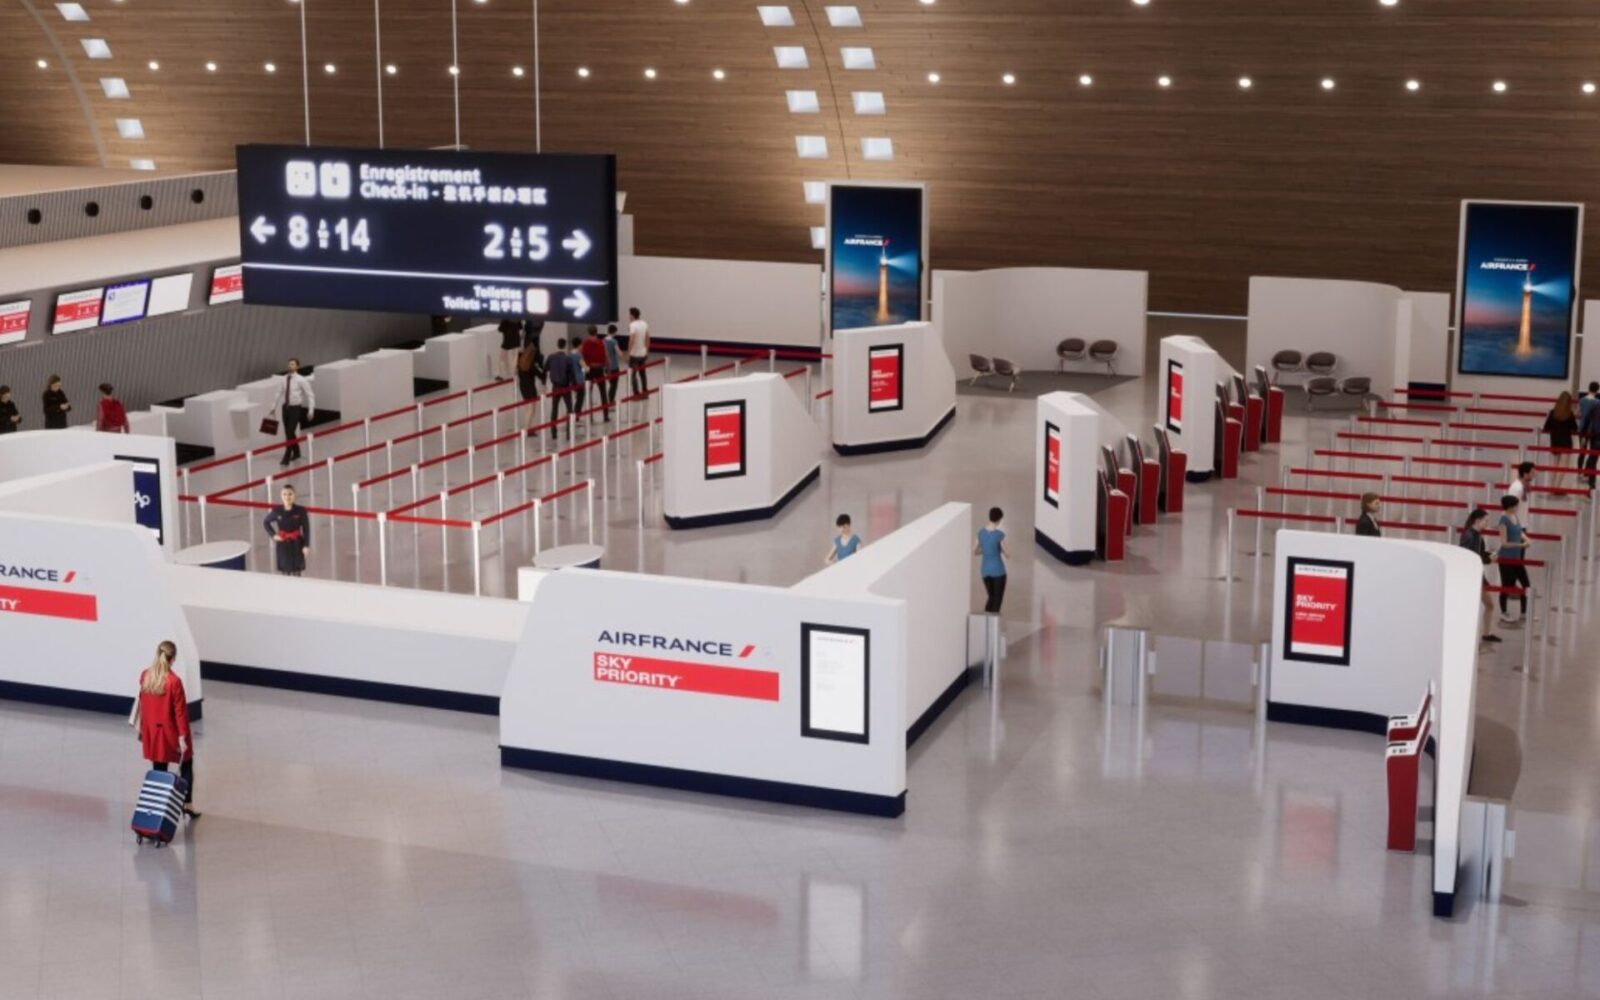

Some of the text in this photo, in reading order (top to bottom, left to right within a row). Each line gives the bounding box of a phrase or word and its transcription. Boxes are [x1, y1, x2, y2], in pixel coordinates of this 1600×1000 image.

[360, 163, 481, 184] Enregistrement
[360, 181, 428, 200] Check-in
[288, 214, 309, 250] 8
[335, 217, 371, 252] 14
[483, 223, 504, 259] 2
[528, 225, 549, 260] 5
[473, 285, 522, 300] Toilettes
[442, 296, 480, 311] Toilets
[1296, 601, 1337, 611] PRIORITY
[598, 630, 732, 656] AIRFRANCE
[597, 654, 632, 670] SKY
[597, 668, 680, 688] PRIORITY
